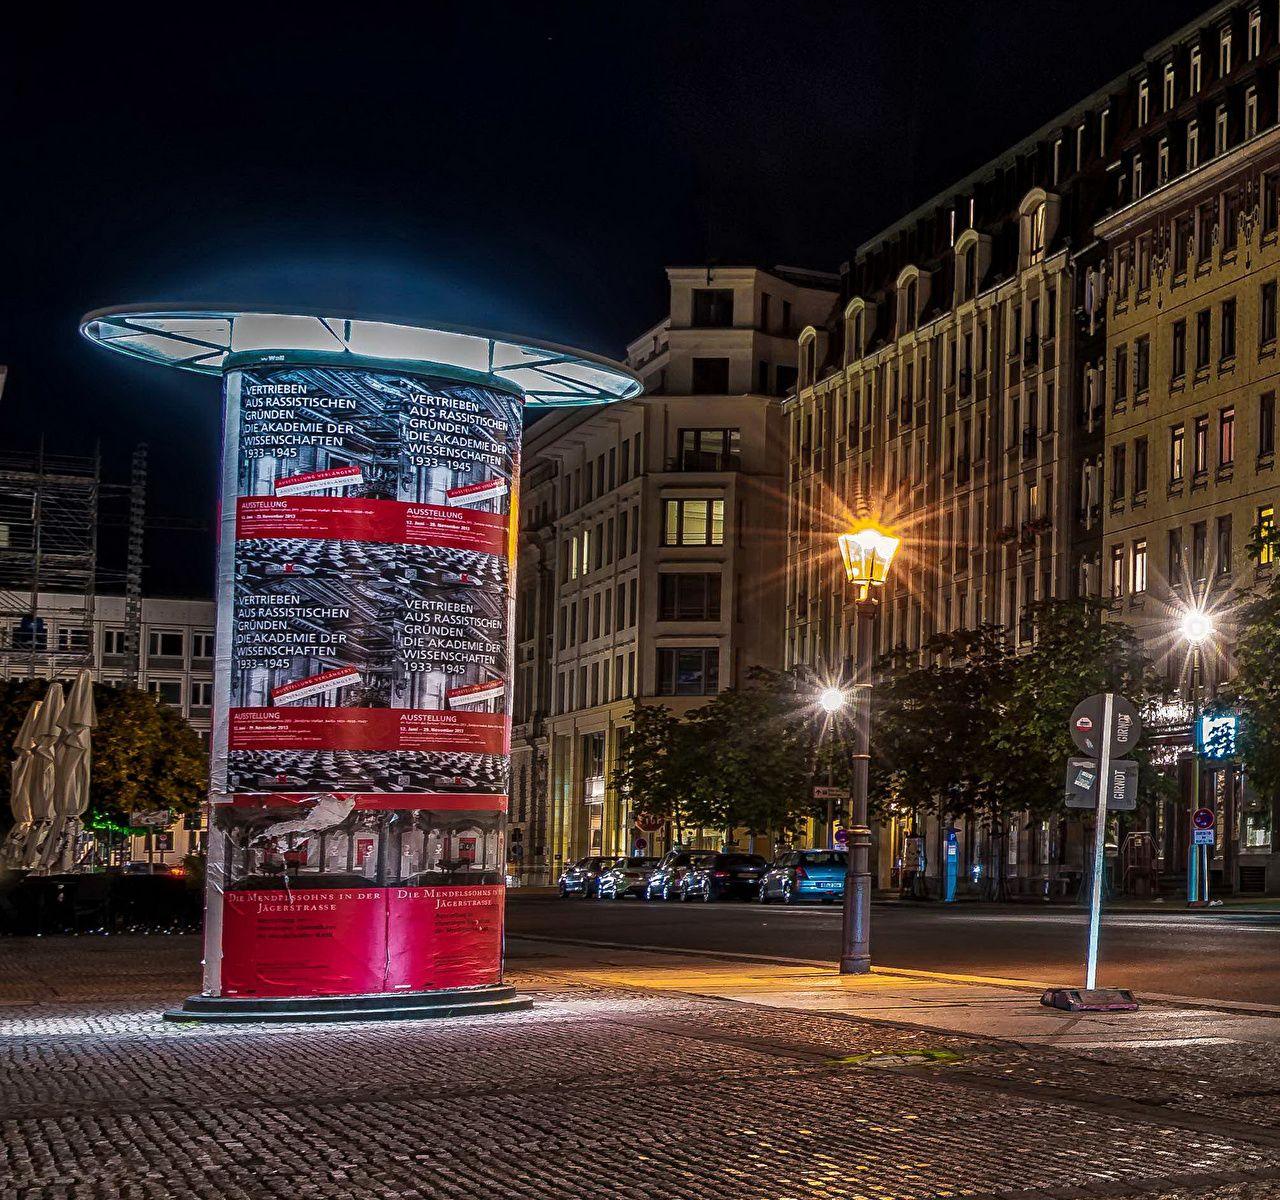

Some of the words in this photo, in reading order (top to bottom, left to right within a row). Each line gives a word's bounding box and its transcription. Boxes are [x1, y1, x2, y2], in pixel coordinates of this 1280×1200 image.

[245, 384, 307, 395] VERTRIEBEN
[245, 398, 264, 408] AUS
[265, 397, 356, 409] RASSISTISCHEN
[409, 393, 479, 412] VERTRIEBEN
[409, 406, 436, 417] AUS
[439, 409, 508, 431] RASSISTISCHEN
[244, 423, 259, 433] DIE
[261, 422, 323, 432] AKADEMIE
[327, 423, 354, 434] DER
[244, 435, 343, 446] WISSENSCHAFTEN
[409, 431, 430, 441] DIE
[433, 433, 489, 451] AKADEMIE
[491, 444, 507, 455] DER
[409, 443, 501, 466] WISSENSCHAFTEN
[278, 475, 315, 485] AUSSTELLUNG
[241, 501, 288, 509] AUSSTELLUNG
[406, 507, 463, 520] AUSSTELLUNG
[239, 595, 300, 605] VERTRIEBEN
[239, 608, 256, 618] AUS
[258, 607, 349, 618] RASSISTISCHEN
[404, 599, 473, 614] VERTRIEBEN
[404, 612, 431, 622] AUS
[434, 614, 502, 629] RASSISTISCHEN
[237, 634, 251, 644] DIE
[253, 633, 316, 643] AKADEMIE
[320, 634, 347, 644] DER
[237, 646, 336, 656] WISSENSCHAFTEN
[404, 637, 424, 647] DIE
[428, 639, 483, 651] AKADEMIE
[486, 643, 501, 653] DER
[403, 649, 495, 664] WISSENSCHAFTEN
[234, 712, 280, 720] AUSSTELLUNG
[400, 714, 457, 723] AUSSTELLUNG
[1117, 713, 1130, 743] GIRNDT
[1113, 769, 1126, 800] GIRNDT
